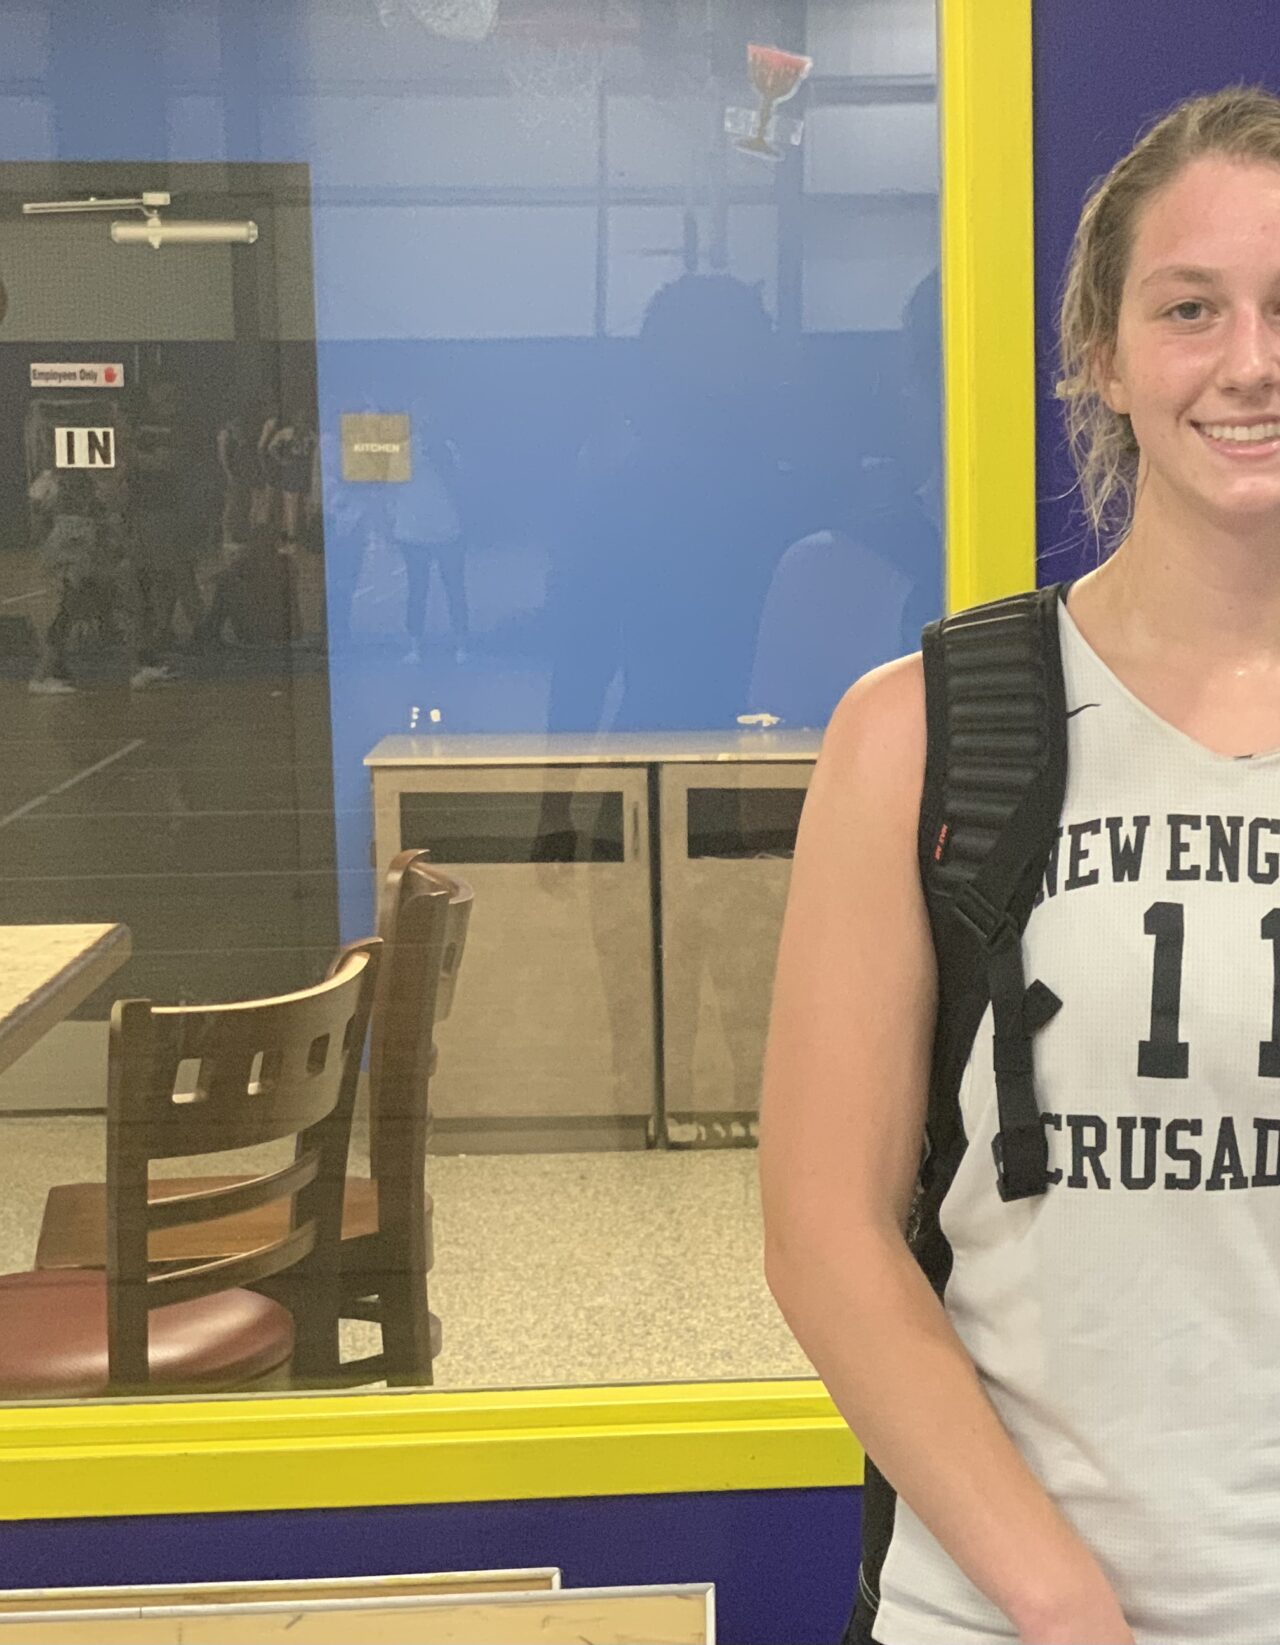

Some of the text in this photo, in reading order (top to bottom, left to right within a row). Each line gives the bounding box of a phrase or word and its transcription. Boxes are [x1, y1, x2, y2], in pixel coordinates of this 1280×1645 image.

[32, 368, 98, 383] Employees Only
[66, 431, 111, 464] IN
[353, 443, 400, 453] KITCHEN
